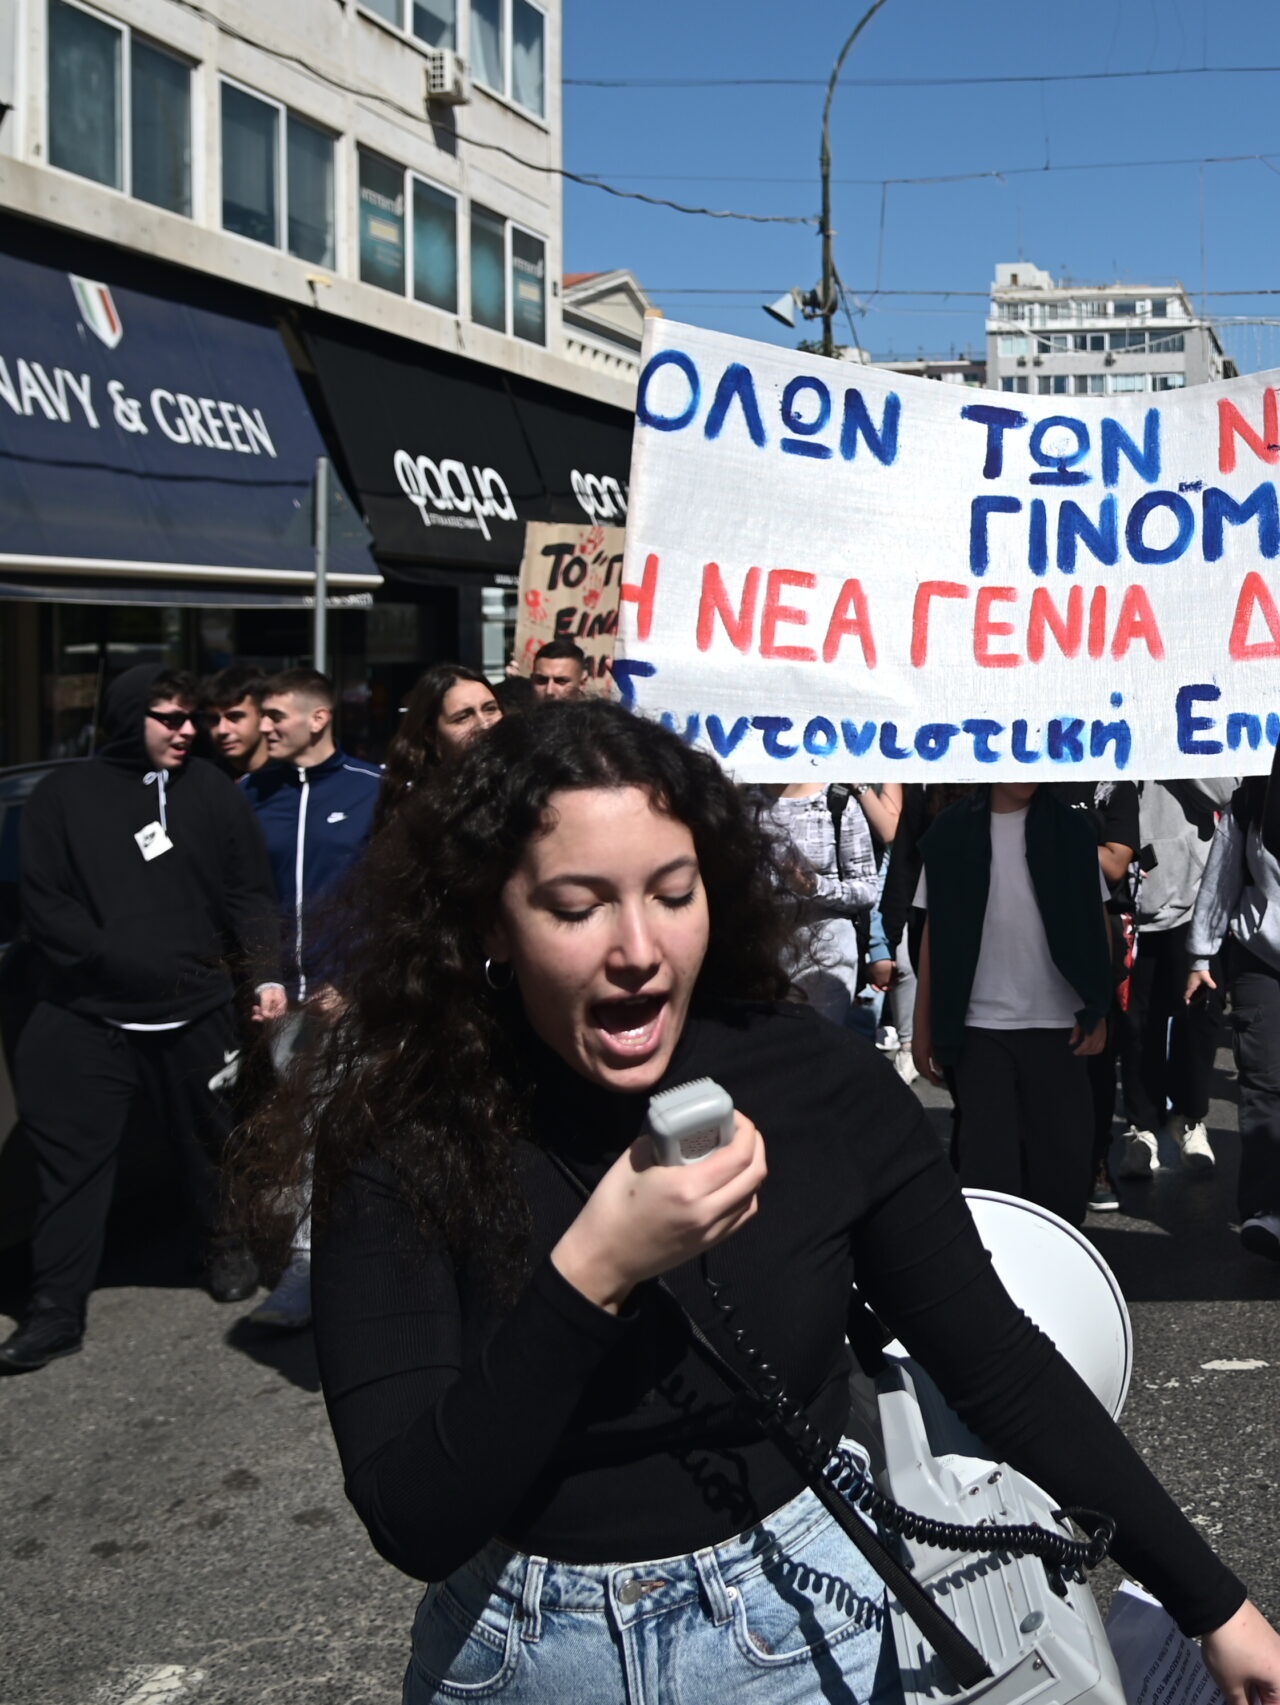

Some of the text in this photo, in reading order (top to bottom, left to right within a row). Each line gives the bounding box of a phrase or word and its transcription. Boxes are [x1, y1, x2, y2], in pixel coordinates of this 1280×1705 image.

[107, 379, 148, 434] &
[150, 388, 277, 458] GREEN
[961, 406, 1161, 487] ΤΩΝ
[696, 562, 877, 669] ΝΕΑ
[910, 580, 1164, 669] ΓΕΝΙΑ
